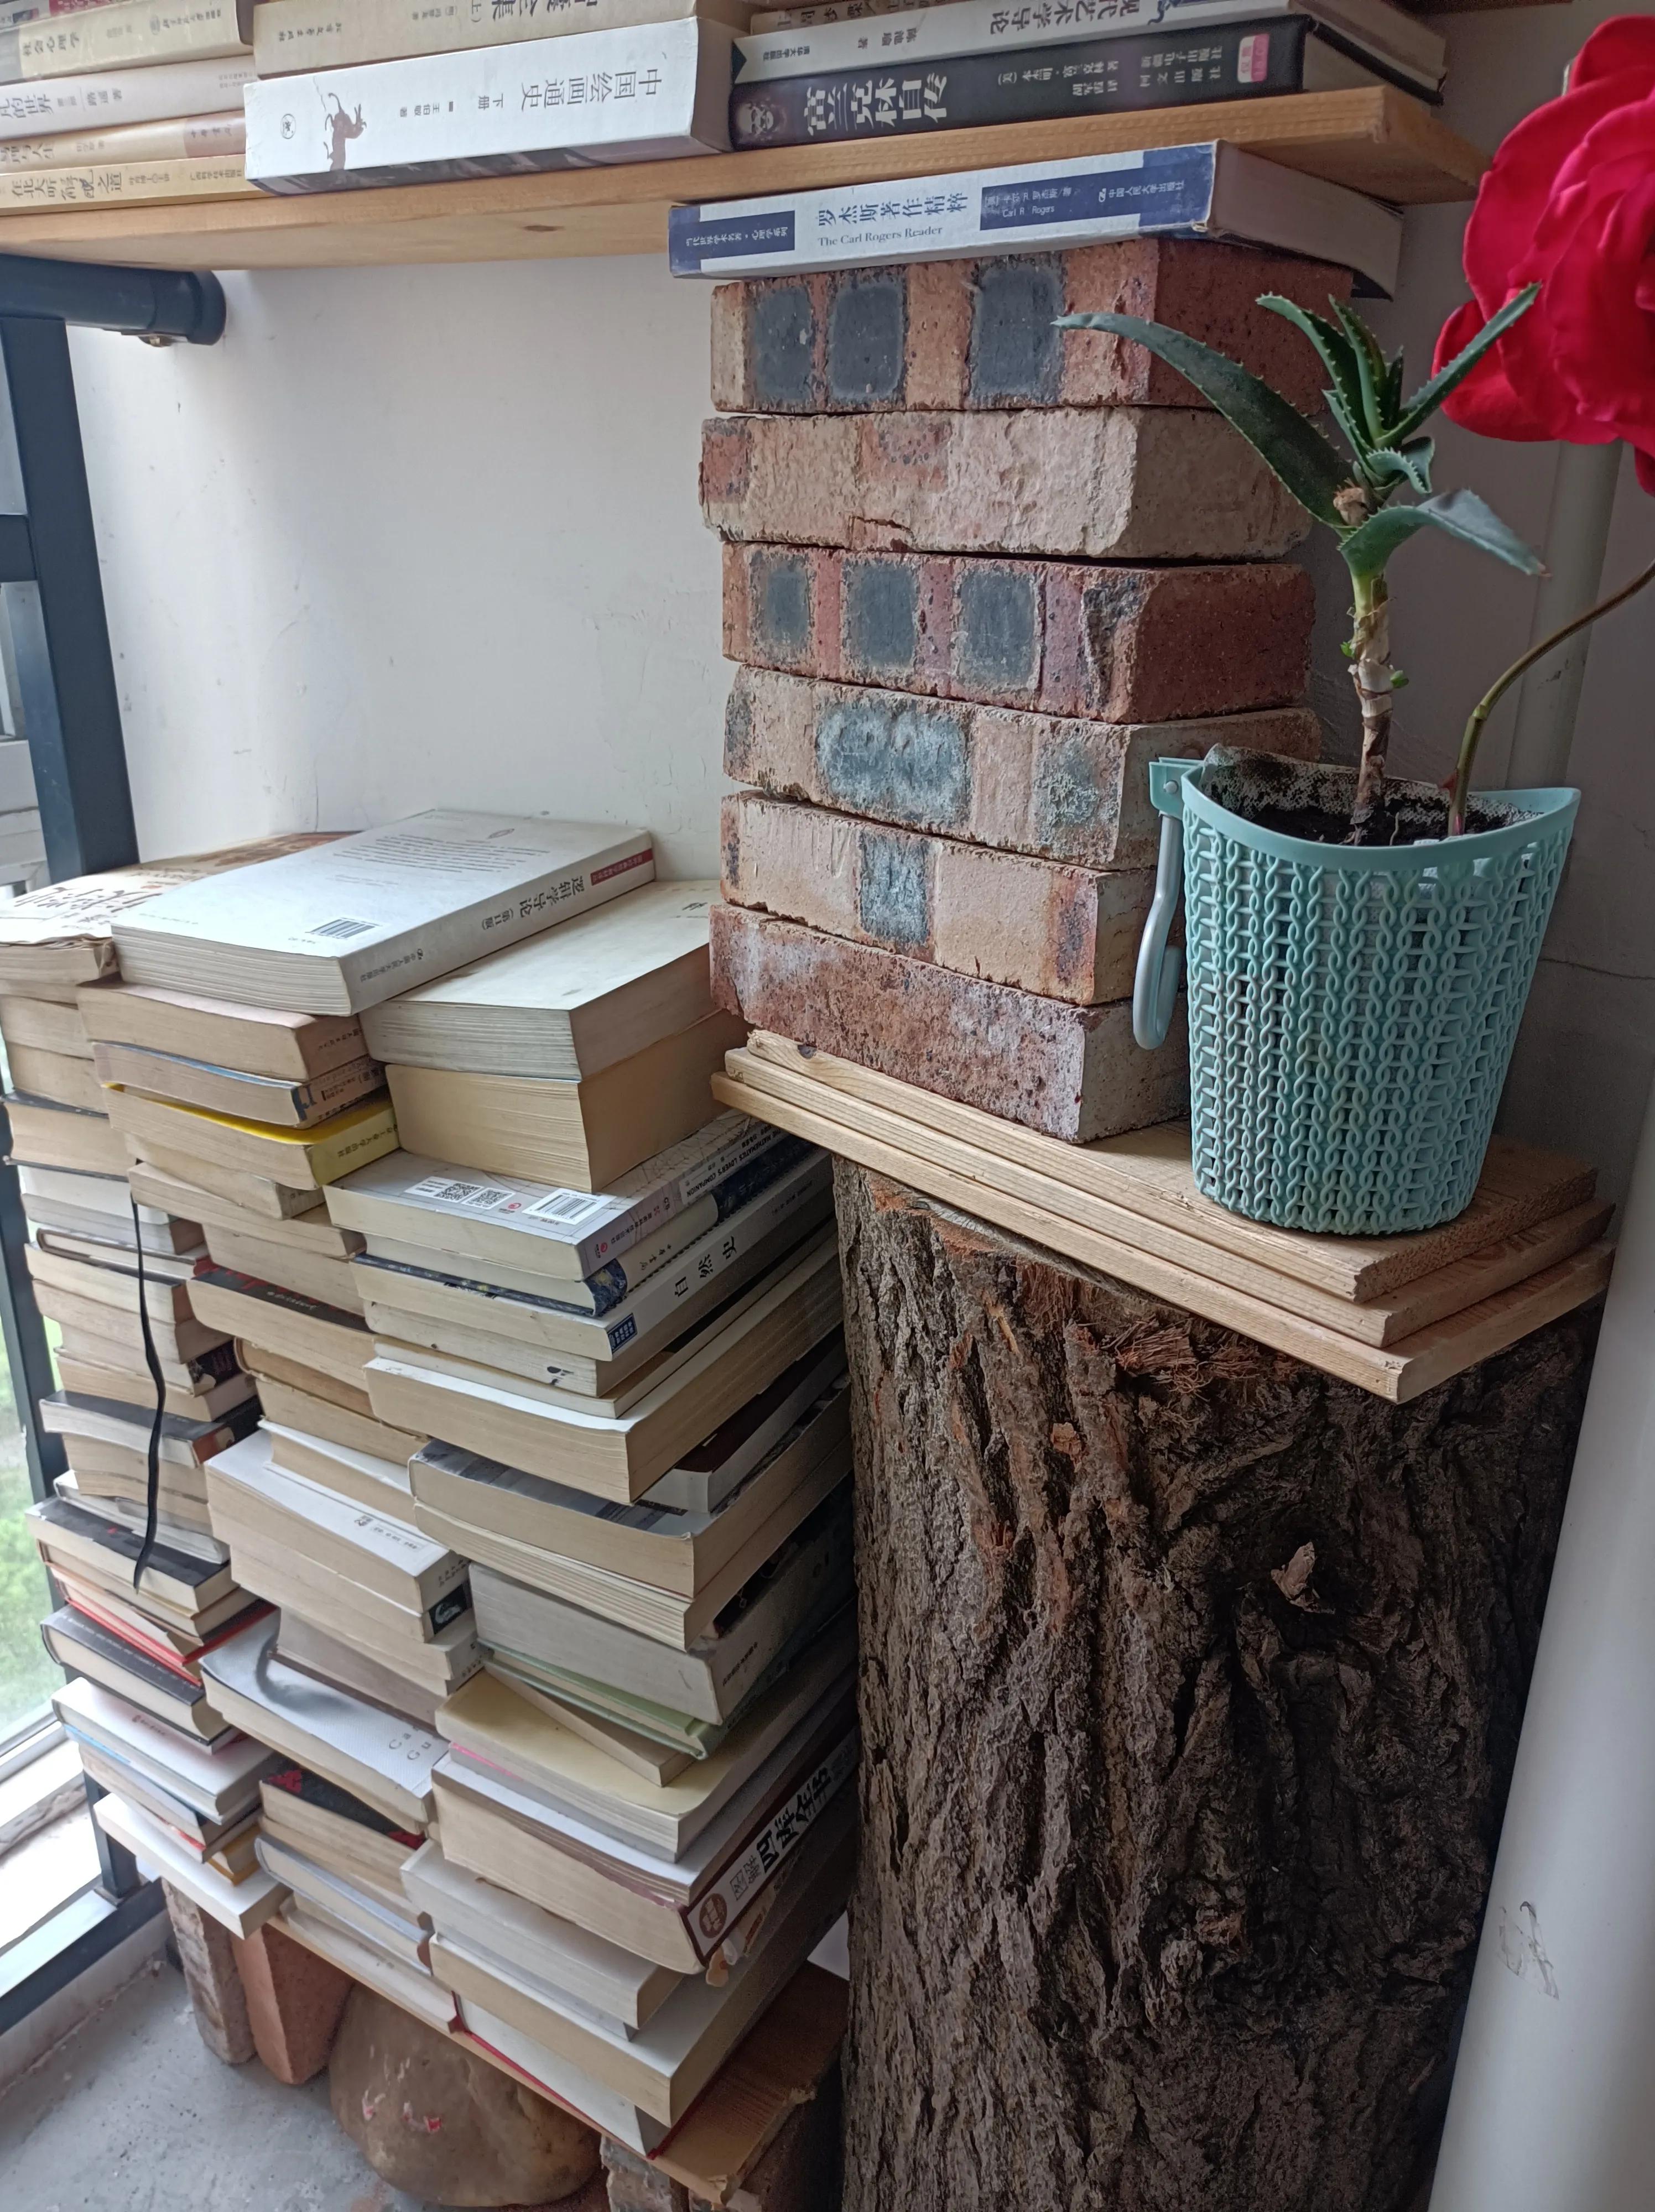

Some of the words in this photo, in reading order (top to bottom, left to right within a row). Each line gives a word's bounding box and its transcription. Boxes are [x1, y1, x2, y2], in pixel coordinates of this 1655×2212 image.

[22, 31, 80, 56] 社会心理学
[763, 45, 810, 62] 清华大学出版社
[478, 93, 503, 110] 下册
[522, 69, 662, 111] 中国绘画通史
[414, 101, 440, 117] 王伯敏
[804, 71, 947, 137] 富兰克林自传
[1108, 180, 1185, 199] 中国人民大学出版社
[818, 191, 968, 227] 罗杰斯著作精粹
[1002, 207, 1017, 218] Carl
[1032, 205, 1055, 216] Rogers
[818, 237, 839, 247] The
[840, 233, 862, 245] Carl
[865, 230, 902, 244] Rogers
[904, 225, 943, 238] Reader
[520, 875, 585, 919] 逻辑学导论
[686, 1172, 717, 1198] COMPANION
[674, 1235, 737, 1297] 自然史
[756, 1766, 832, 1874] 四库全书
